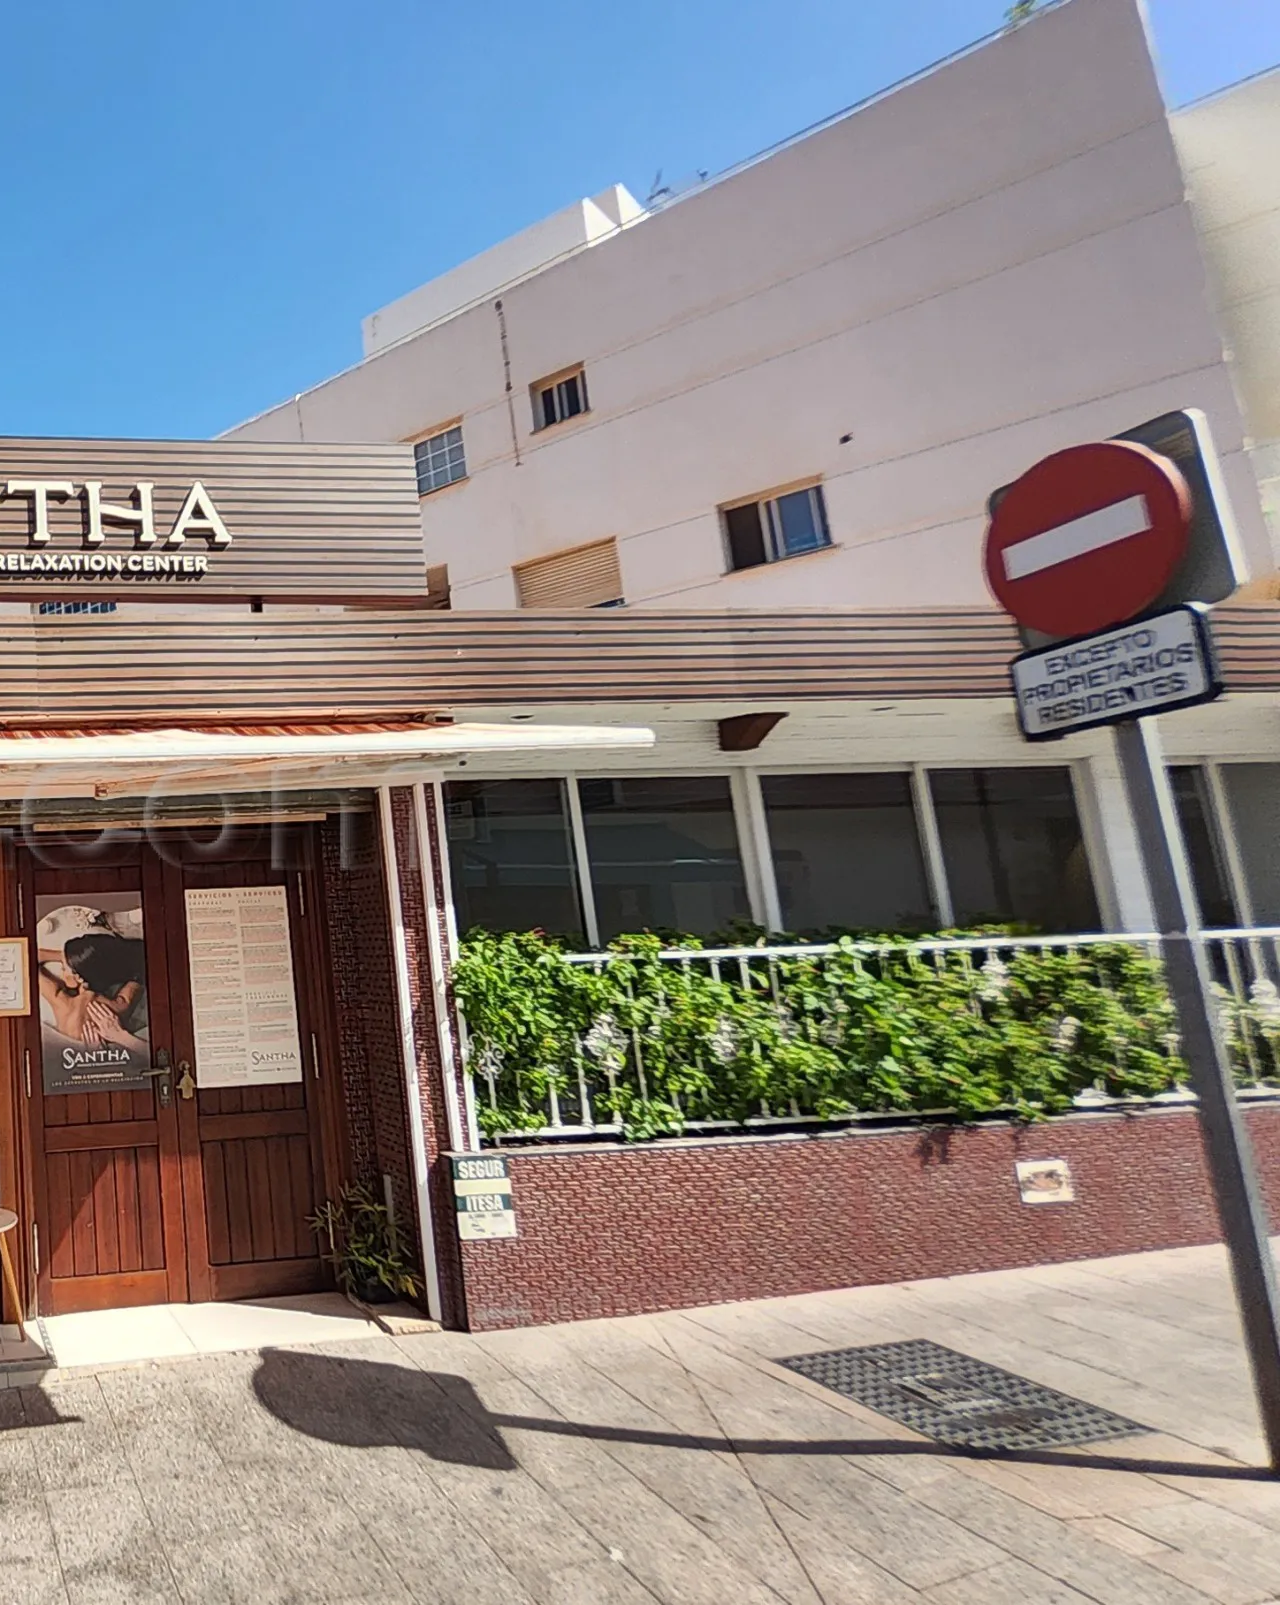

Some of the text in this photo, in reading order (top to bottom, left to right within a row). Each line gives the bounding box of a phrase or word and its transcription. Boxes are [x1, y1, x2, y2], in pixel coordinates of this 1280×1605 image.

[124, 552, 209, 572] CENTER
[1044, 628, 1157, 676] EXCEPTO
[1022, 642, 1194, 706] PROPIETARIOS
[1037, 671, 1189, 724] RESIDENTES
[62, 1047, 130, 1069] SANTHA
[251, 1050, 296, 1066] SANTHA
[458, 1160, 505, 1179] SEGUR
